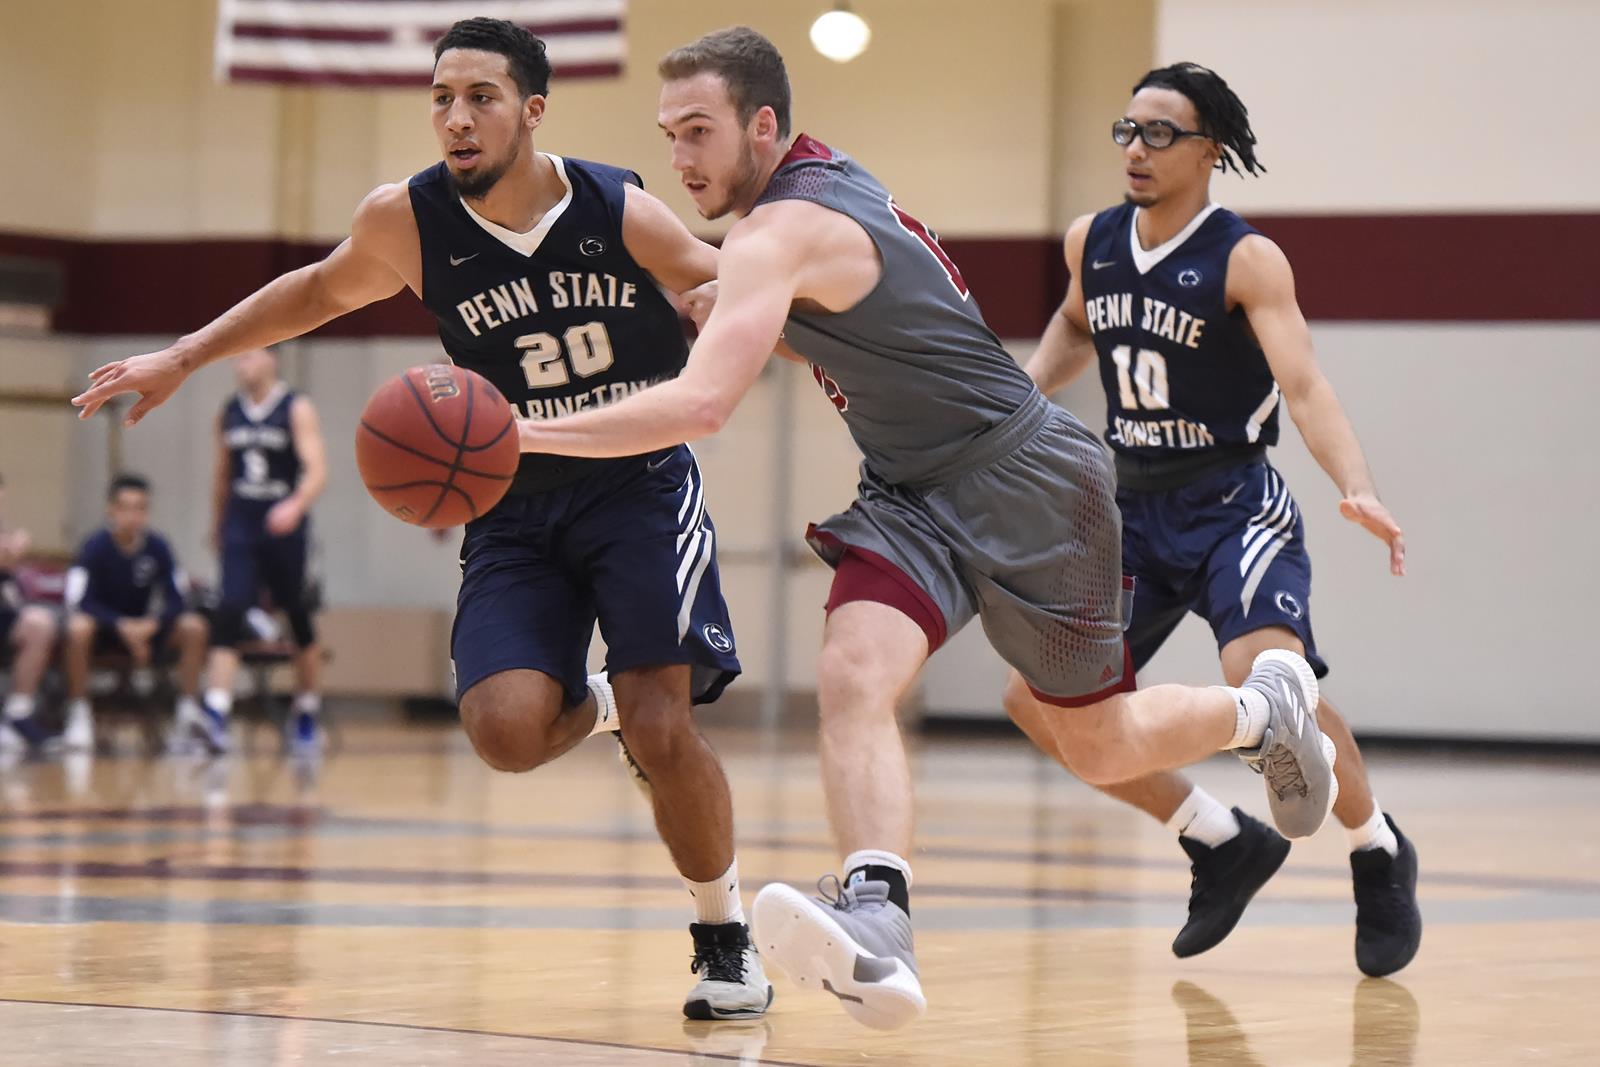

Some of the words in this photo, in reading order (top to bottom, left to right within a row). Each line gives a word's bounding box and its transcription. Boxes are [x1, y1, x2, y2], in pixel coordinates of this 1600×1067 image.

[456, 277, 539, 337] PENN
[548, 271, 637, 309] STATE
[1086, 293, 1133, 335] PENN
[1141, 296, 1206, 349] STATE
[514, 321, 614, 390] 20
[1111, 344, 1170, 411] 10
